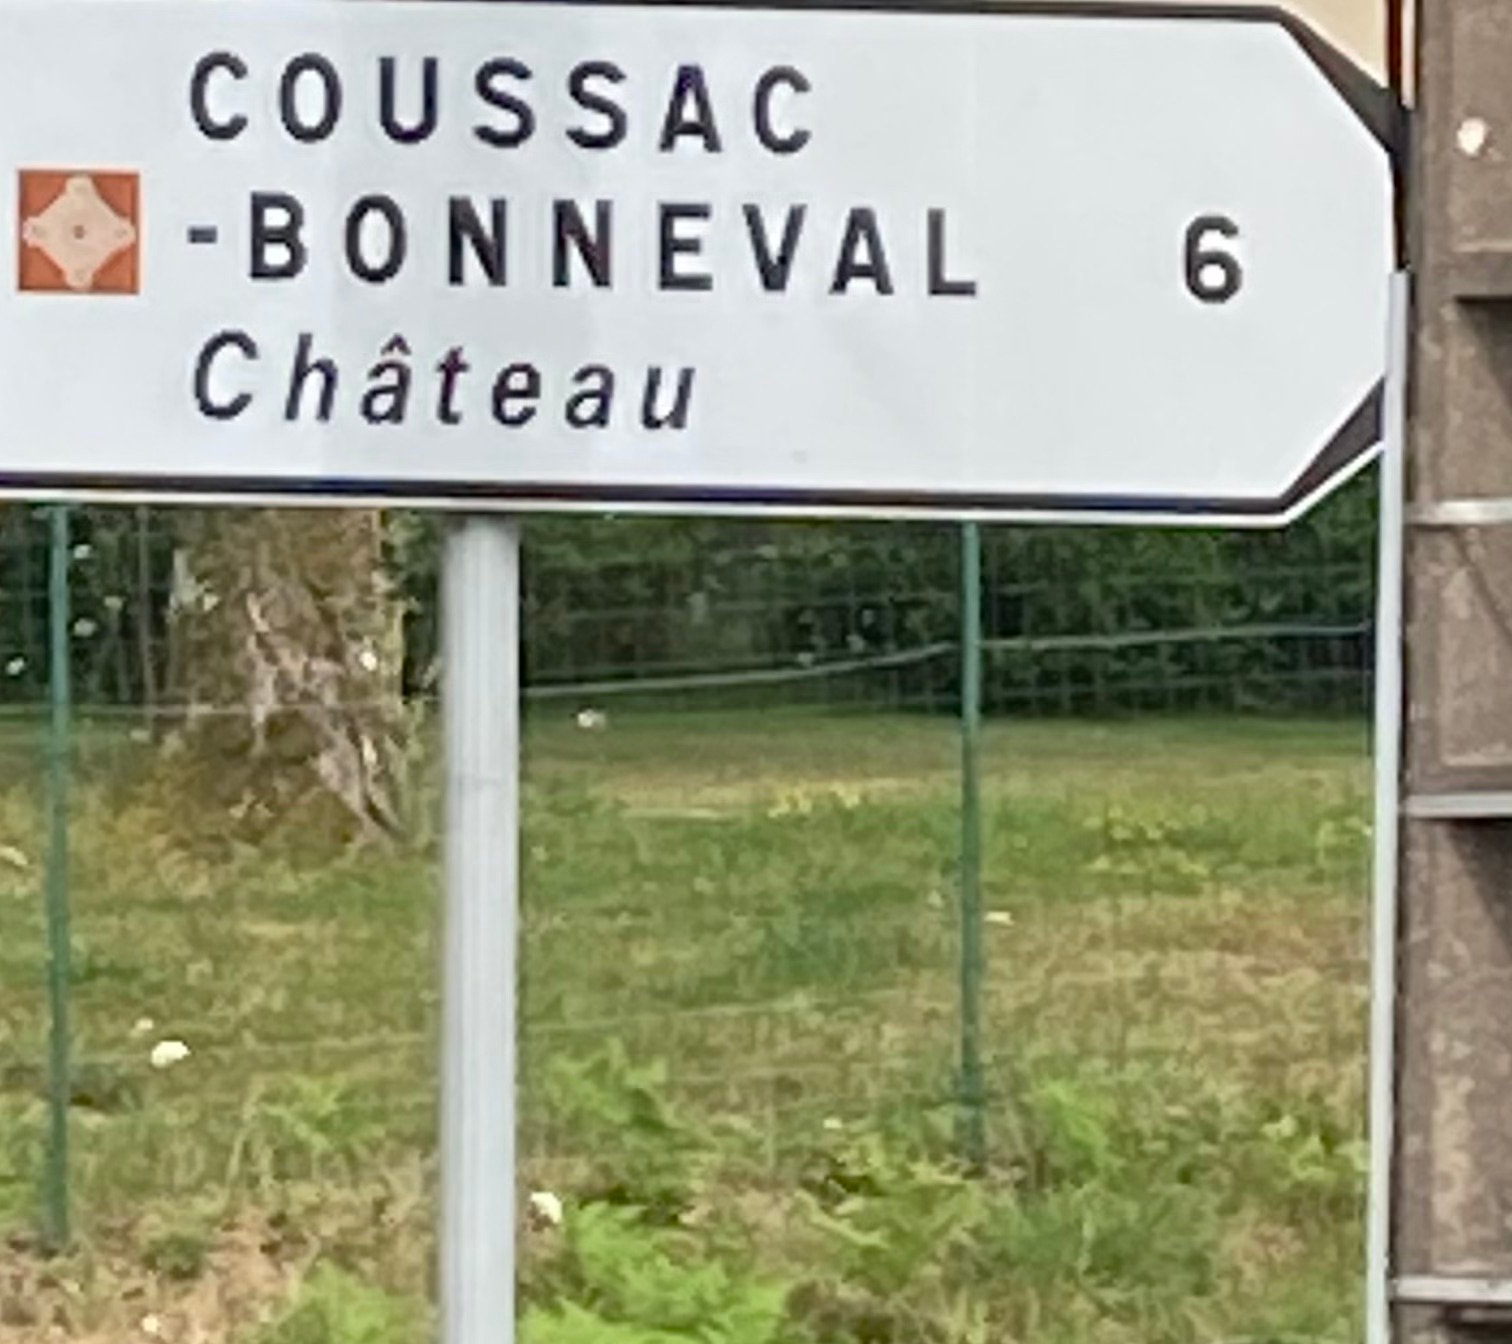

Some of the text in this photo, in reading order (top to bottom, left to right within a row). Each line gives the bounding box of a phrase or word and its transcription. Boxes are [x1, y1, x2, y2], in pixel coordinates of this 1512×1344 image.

[190, 52, 810, 154] COUSSAC
[188, 192, 1243, 304] -BONNEVAL 6
[194, 331, 695, 430] Château
